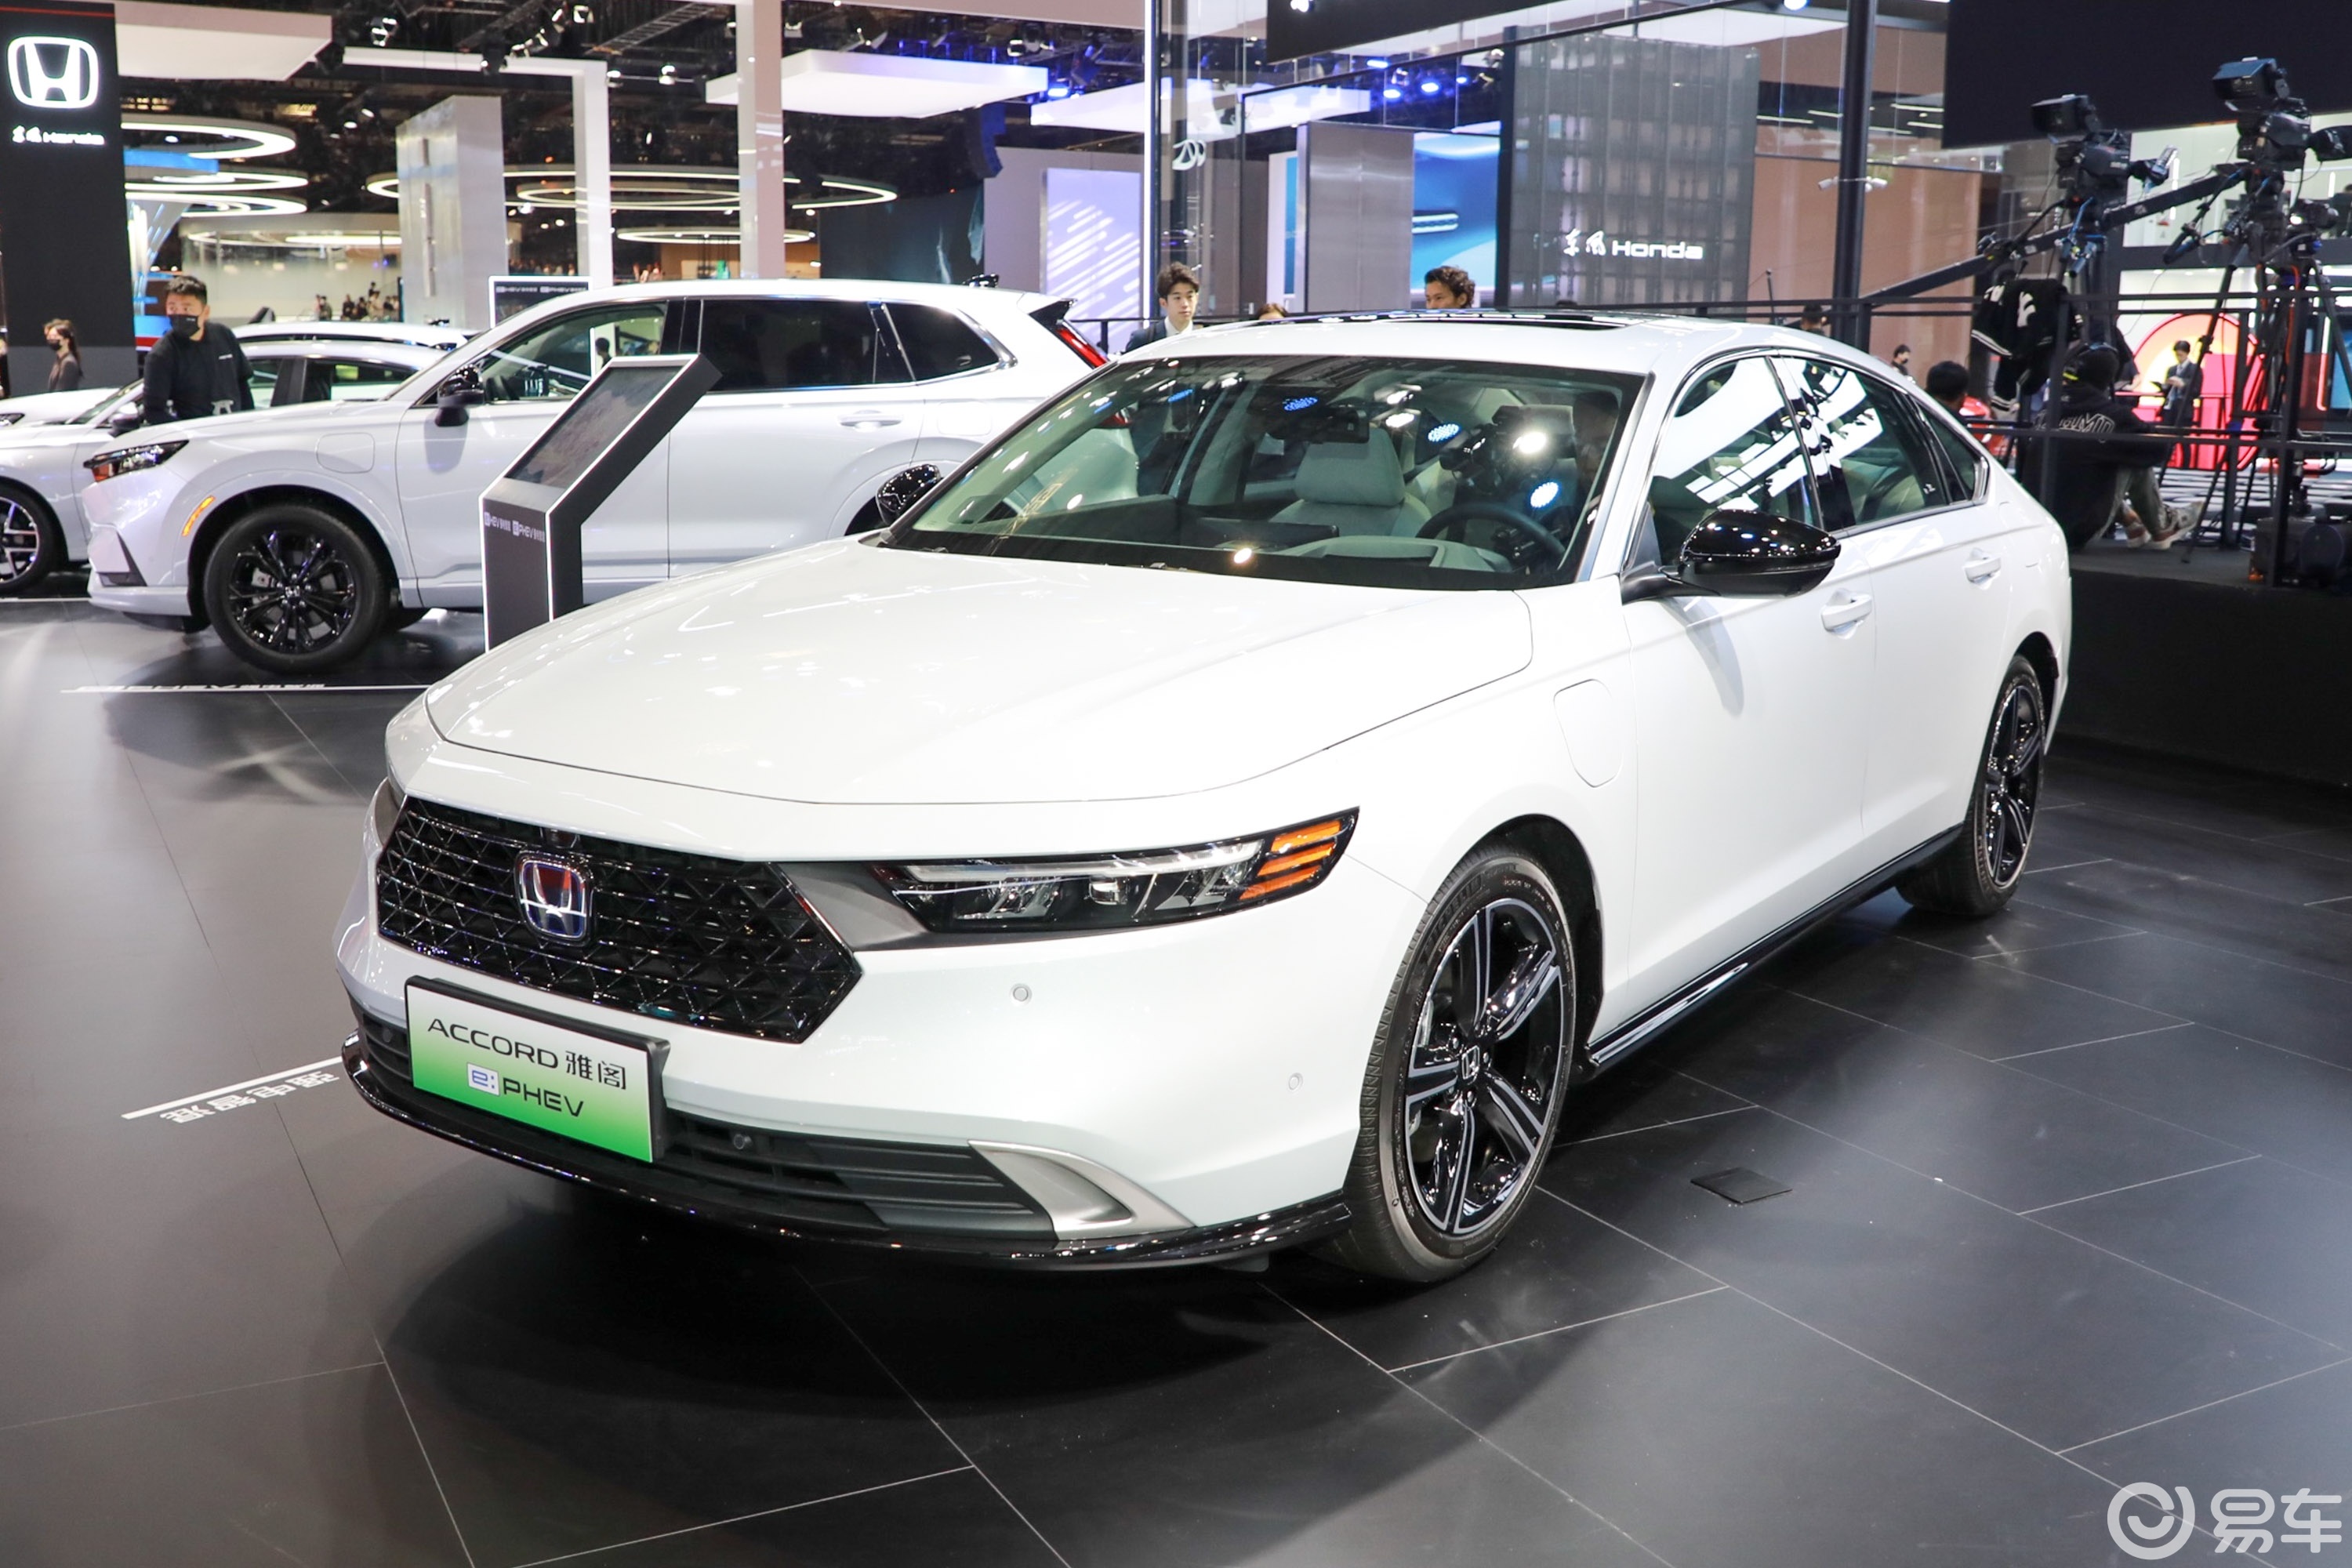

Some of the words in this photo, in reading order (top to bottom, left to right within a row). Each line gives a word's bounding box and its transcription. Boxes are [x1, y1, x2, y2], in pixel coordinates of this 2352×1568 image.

[1612, 240, 1704, 260] Honda
[427, 1018, 559, 1069] ACCORD
[565, 1049, 626, 1090] 雅阁
